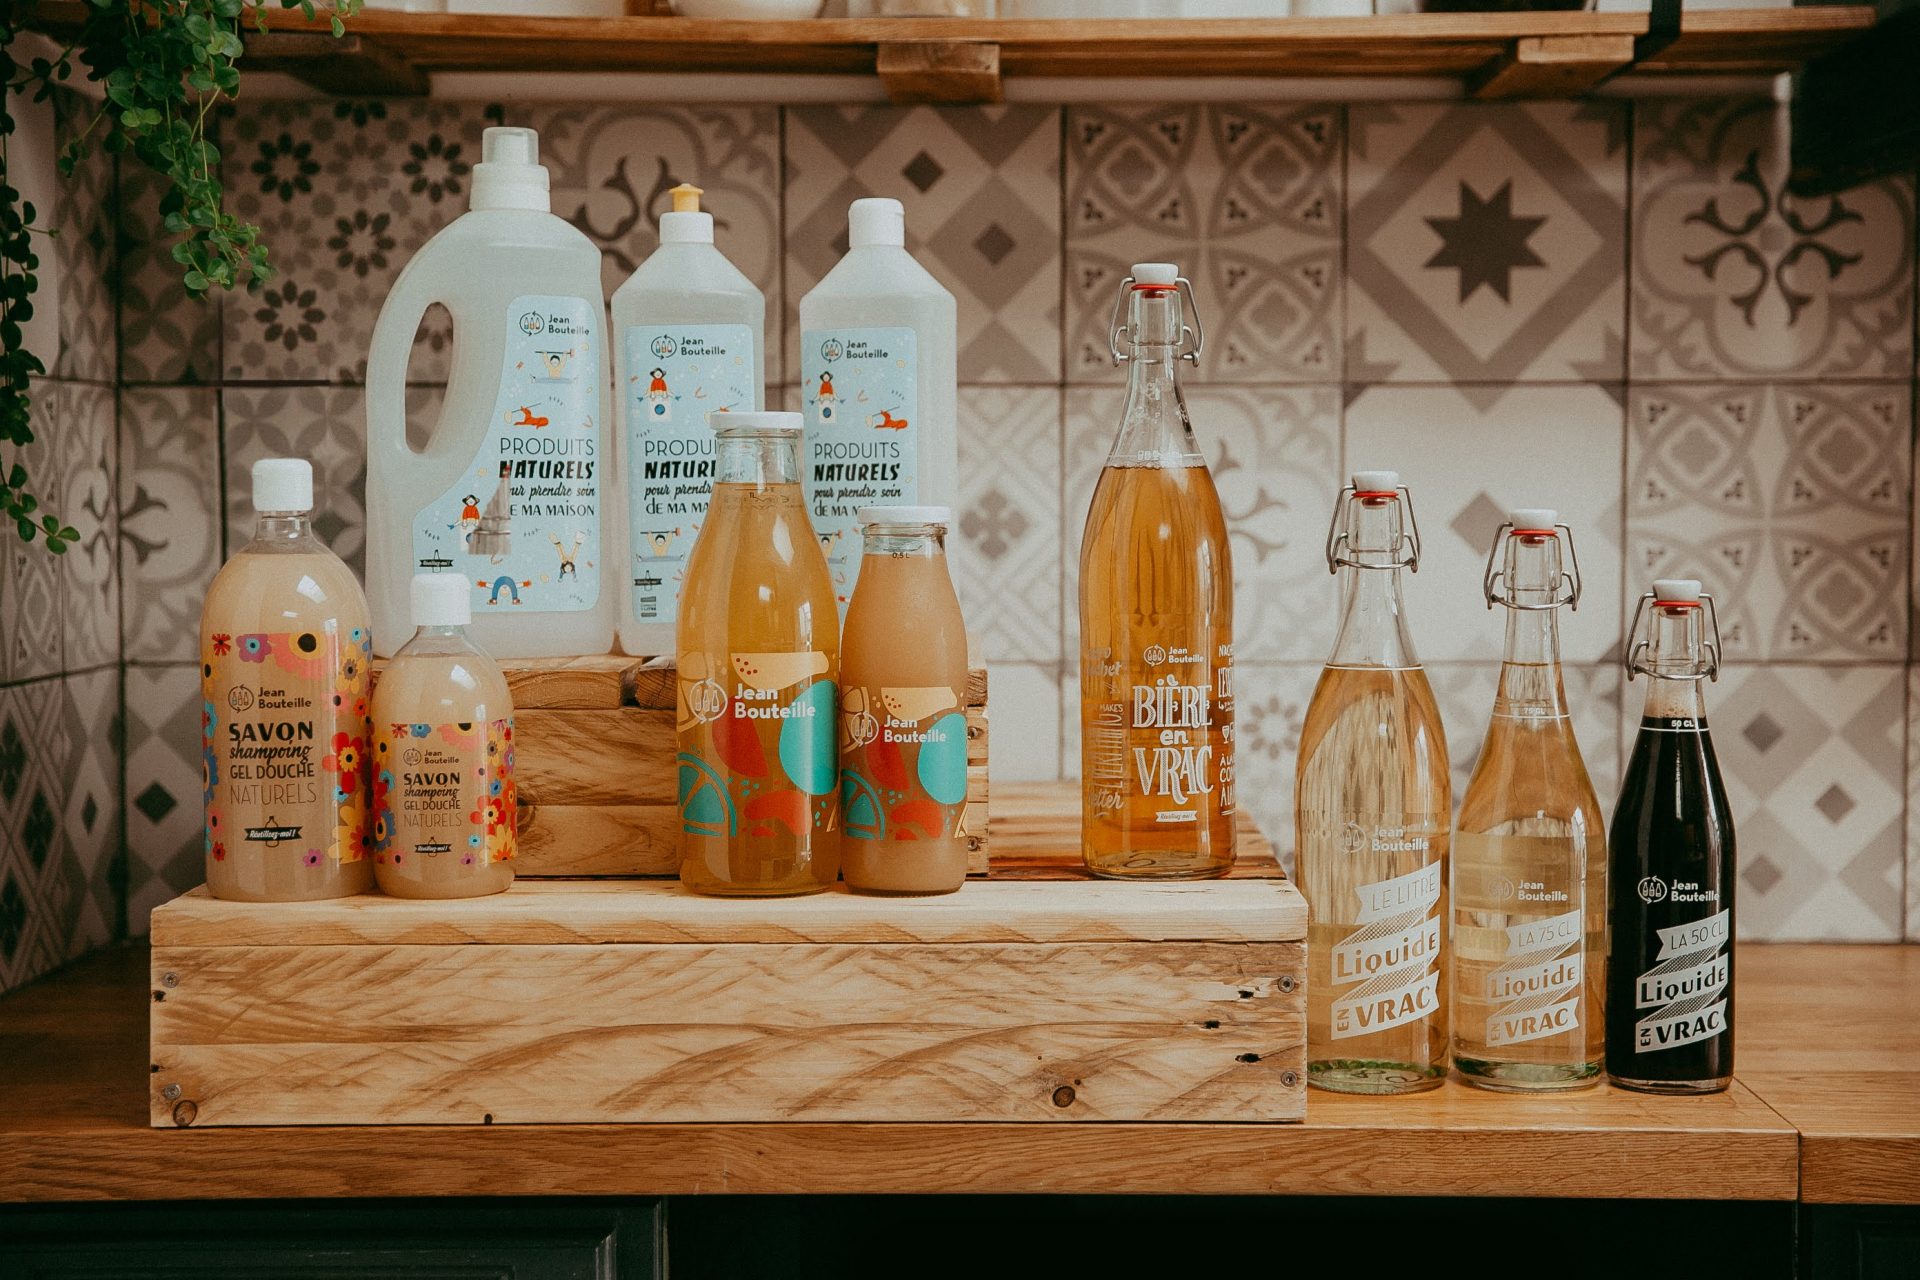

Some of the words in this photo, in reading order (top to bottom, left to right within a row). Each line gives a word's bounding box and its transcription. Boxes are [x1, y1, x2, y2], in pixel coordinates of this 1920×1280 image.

[548, 314, 570, 324] Jean
[548, 325, 590, 335] Bouteille
[681, 336, 704, 346] Jean
[846, 340, 867, 349] Jean
[681, 346, 726, 356] Bouteille
[846, 350, 889, 359] Bouteille
[500, 437, 594, 456] PRODUITS
[644, 439, 716, 457] PRODUI
[814, 442, 900, 459] PRODUITS
[814, 463, 900, 481] NATURELS
[528, 481, 572, 501] prendre
[576, 482, 595, 497] soin
[644, 484, 671, 501] pour
[674, 480, 712, 500] prendr
[813, 487, 833, 502] pour
[837, 483, 876, 502] prendre
[881, 484, 902, 498] soin
[521, 504, 541, 517] MA
[667, 503, 687, 514] MA
[831, 505, 848, 517] MA
[1168, 646, 1188, 655] Jean
[1168, 654, 1204, 664] Bouteille
[258, 687, 285, 698] Jean
[735, 684, 778, 700] Jean
[258, 699, 312, 710] Bouteille
[1132, 674, 1213, 729] BIÈRE
[734, 701, 816, 719] Bouteille
[884, 715, 918, 729] Jean
[1671, 720, 1682, 728] 50
[1683, 720, 1695, 728] CL
[229, 721, 313, 742] SAVON
[884, 729, 947, 744] Bouteille
[1160, 729, 1188, 746] en
[229, 740, 313, 766] shampoing
[424, 757, 460, 765] Bouteille
[230, 764, 252, 780] GEL
[256, 762, 315, 780] DOUCHE
[1132, 744, 1214, 806] VRAC
[403, 772, 461, 786] SAVON
[230, 783, 317, 806] NATURELS
[403, 784, 460, 802] shampoing
[404, 800, 420, 811] GEL
[422, 799, 461, 811] DOUCHE
[404, 813, 463, 828] NATURELS
[1374, 825, 1404, 838] Jean
[1371, 838, 1429, 852] Bouteille
[1372, 887, 1391, 911] LE
[1398, 872, 1435, 906] LITRE
[1518, 880, 1544, 890] Jean
[1671, 879, 1699, 890] Jean
[1517, 890, 1569, 902] Bouteille
[1671, 890, 1721, 902] Bouteille
[1518, 932, 1535, 947] LA
[1539, 927, 1554, 944] 75
[1671, 934, 1688, 951] LA
[1691, 927, 1709, 946] 50
[1336, 1007, 1350, 1032] EN
[1355, 985, 1431, 1028] VRAC
[1504, 1007, 1569, 1041] VRAC
[1640, 1027, 1652, 1047] EN
[1655, 1010, 1720, 1045] VRAC
